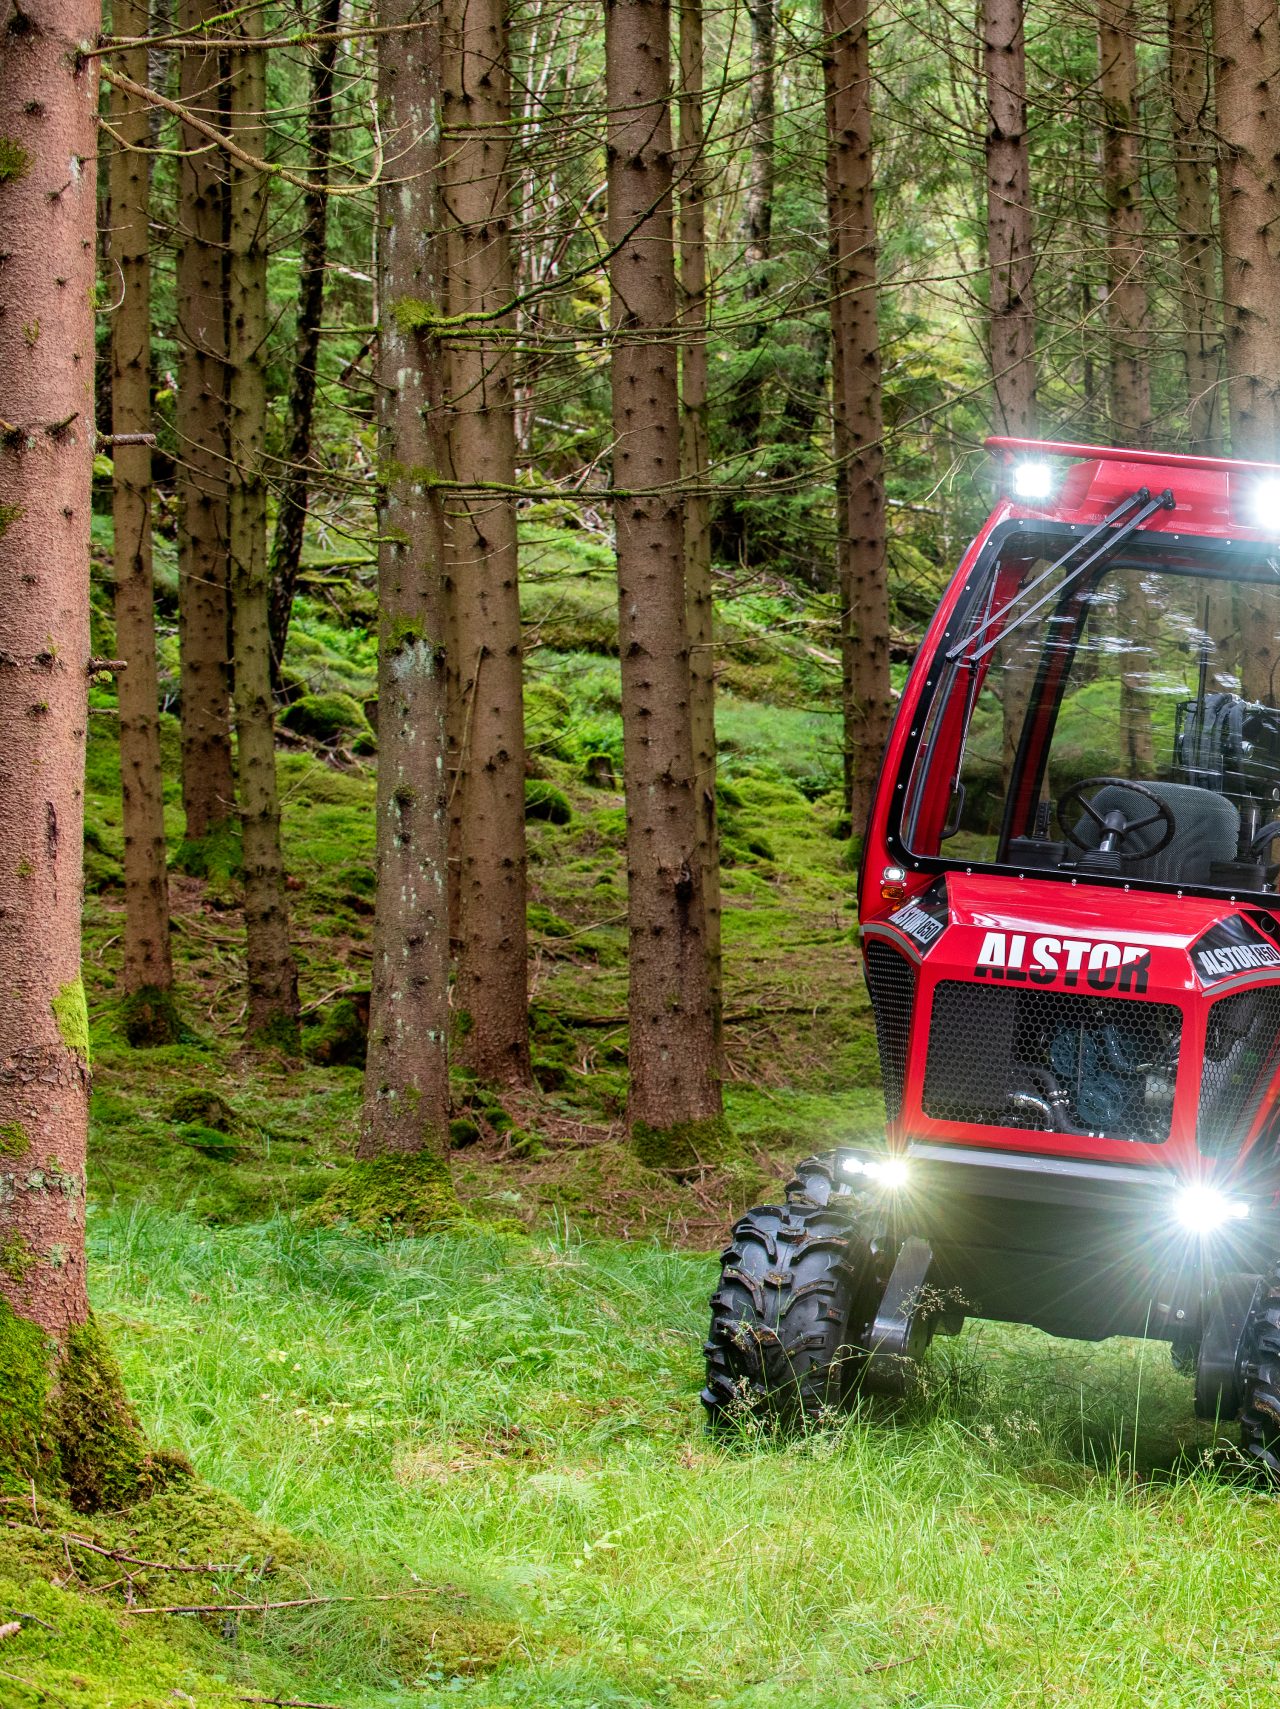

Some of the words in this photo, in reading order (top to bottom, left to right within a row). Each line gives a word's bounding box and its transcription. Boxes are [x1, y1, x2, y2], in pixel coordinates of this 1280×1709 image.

[915, 919, 941, 941] 850
[974, 932, 1151, 994] ALSTOR
[1198, 945, 1262, 976] ALSTOR
